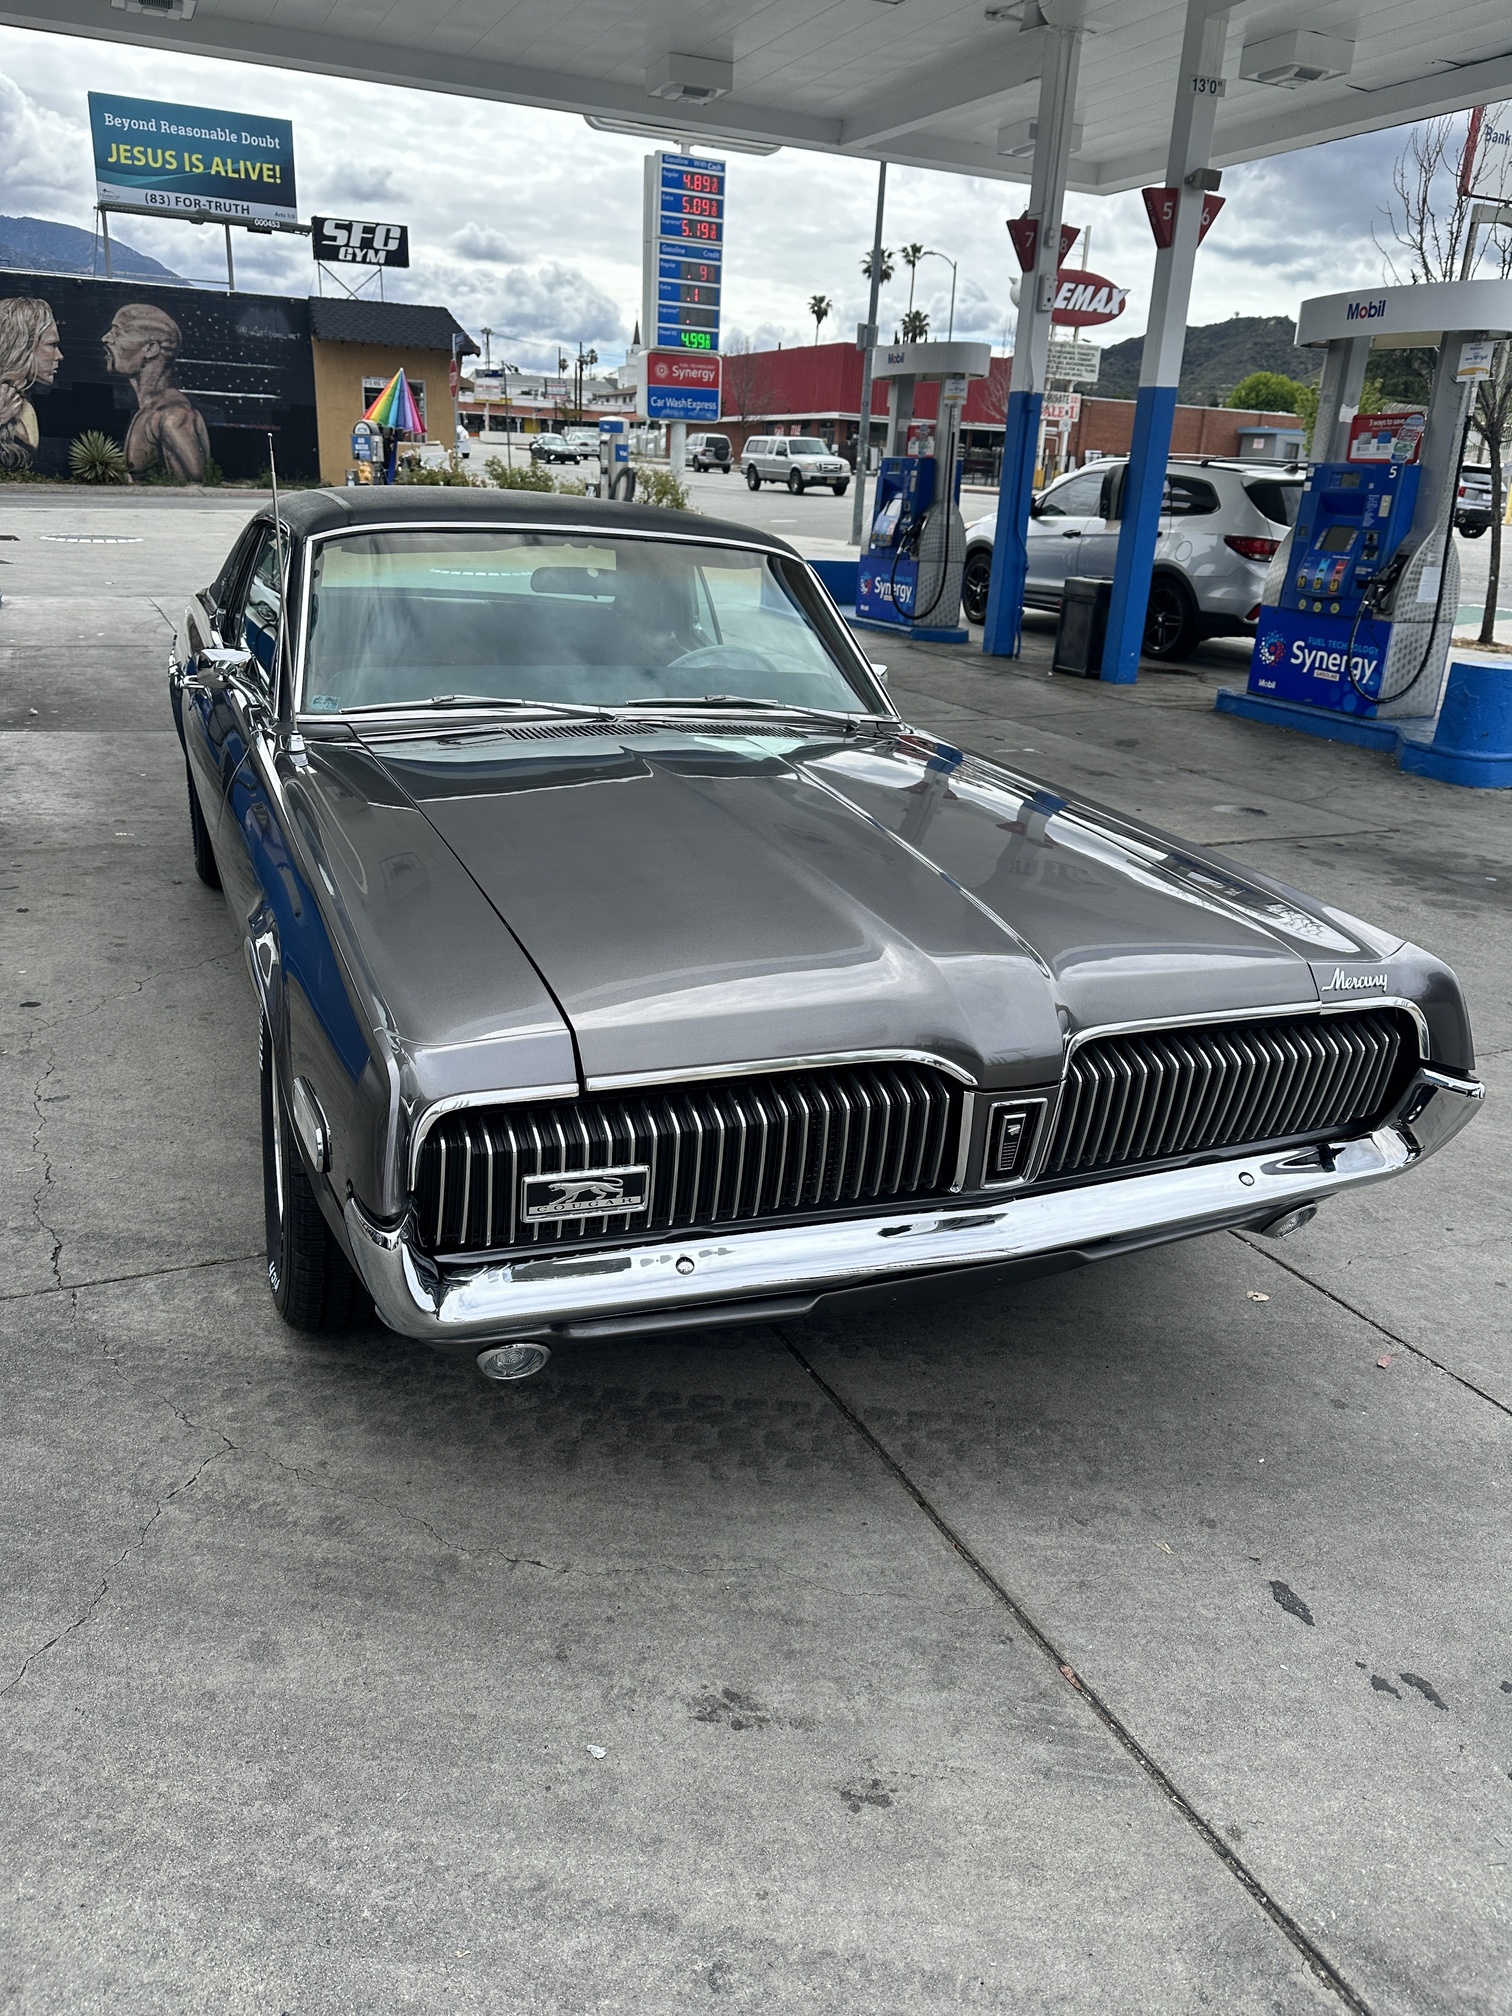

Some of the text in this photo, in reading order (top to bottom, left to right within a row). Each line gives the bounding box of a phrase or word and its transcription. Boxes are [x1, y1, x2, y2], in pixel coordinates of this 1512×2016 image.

[1192, 77, 1223, 95] 13'0"
[104, 113, 280, 149] Beyond Reasonable Doubt
[1485, 124, 1511, 146] Bank
[108, 143, 282, 184] JESUS IS ALIVE!
[664, 156, 689, 165] Gasoline
[707, 162, 722, 171] Cash
[145, 192, 250, 215] (83) FOR-TRUTH
[1162, 202, 1173, 220] 5
[1201, 207, 1211, 225] 6
[322, 218, 401, 251] SFC
[1025, 231, 1035, 248] 7
[662, 245, 720, 259] Gasoline Credit
[1060, 237, 1068, 253] 8
[338, 247, 387, 264] GYM
[1053, 281, 1131, 315] EMAX
[1346, 299, 1387, 321] Mobil
[888, 352, 905, 364] Mobil
[672, 365, 715, 382] Synergy
[651, 397, 717, 412] Car Wash Express
[1388, 465, 1398, 479] 5
[1308, 636, 1379, 655] FUEL TECHOLOGY
[1290, 640, 1378, 684] Synergy
[1258, 679, 1277, 689] Mobil
[1322, 967, 1388, 994] Mercury
[537, 1198, 633, 1212] COUGAR
